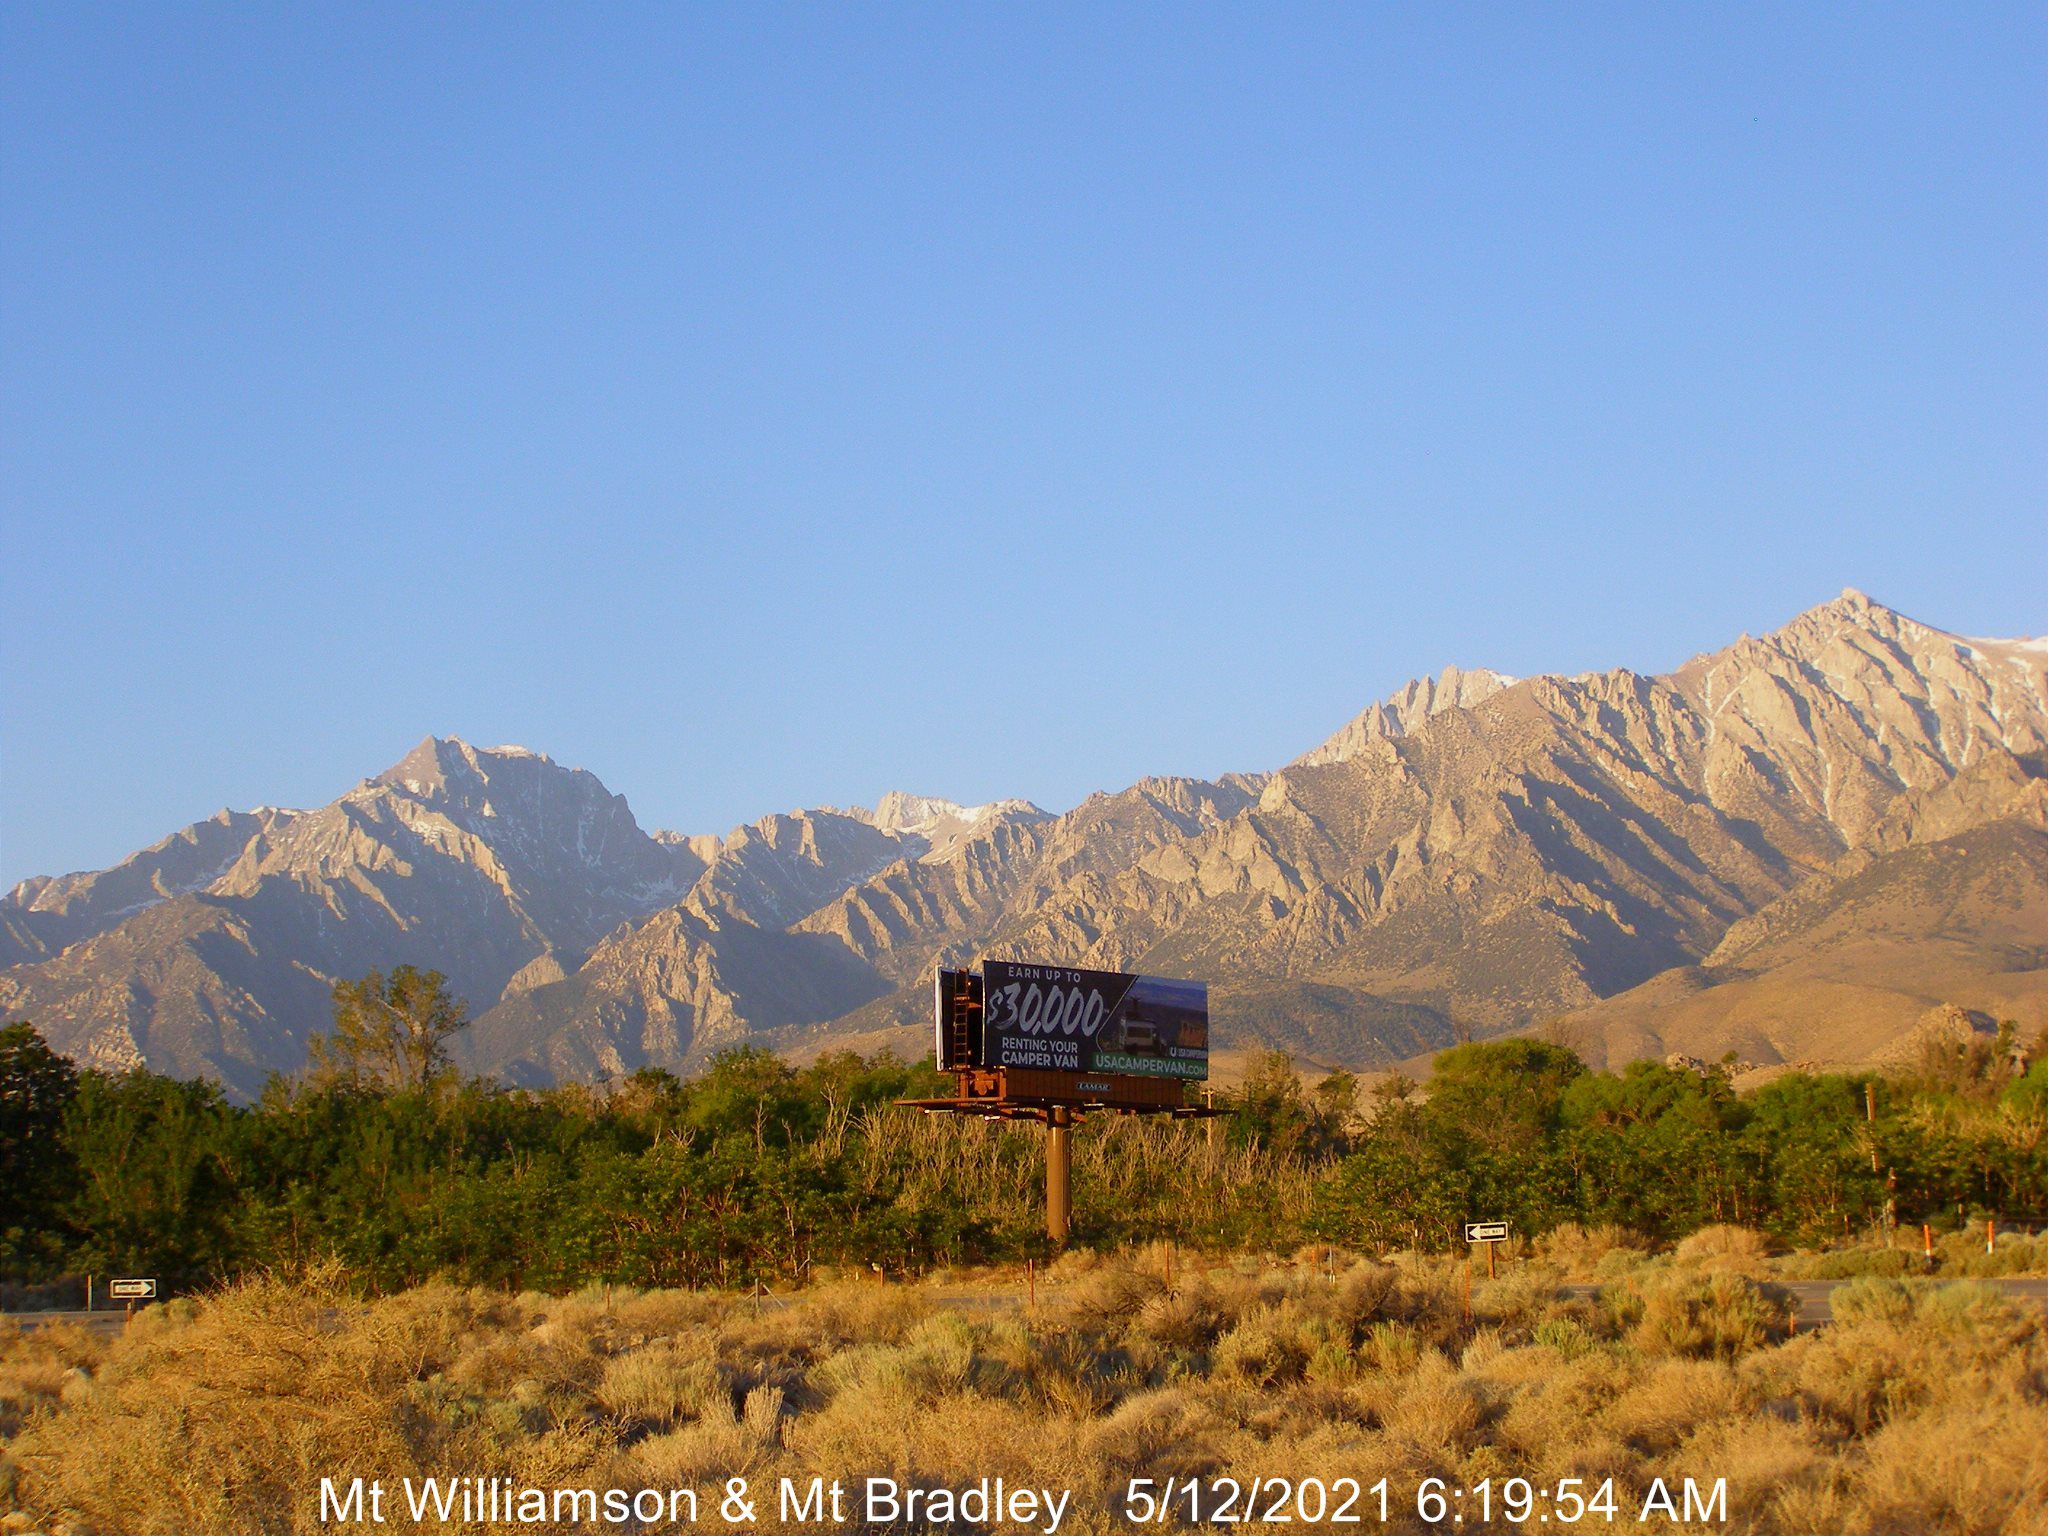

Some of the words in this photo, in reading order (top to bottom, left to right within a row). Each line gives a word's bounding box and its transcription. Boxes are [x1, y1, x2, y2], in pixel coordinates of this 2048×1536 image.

[1008, 966, 1040, 979] EARN
[1046, 970, 1061, 980] UP
[1066, 972, 1081, 983] TO
[987, 982, 1104, 1036] $30,000
[1002, 1037, 1047, 1052] RENTING
[1049, 1041, 1078, 1054] YOUR
[1001, 1051, 1051, 1067] CAMPER
[1054, 1054, 1079, 1068] VAN
